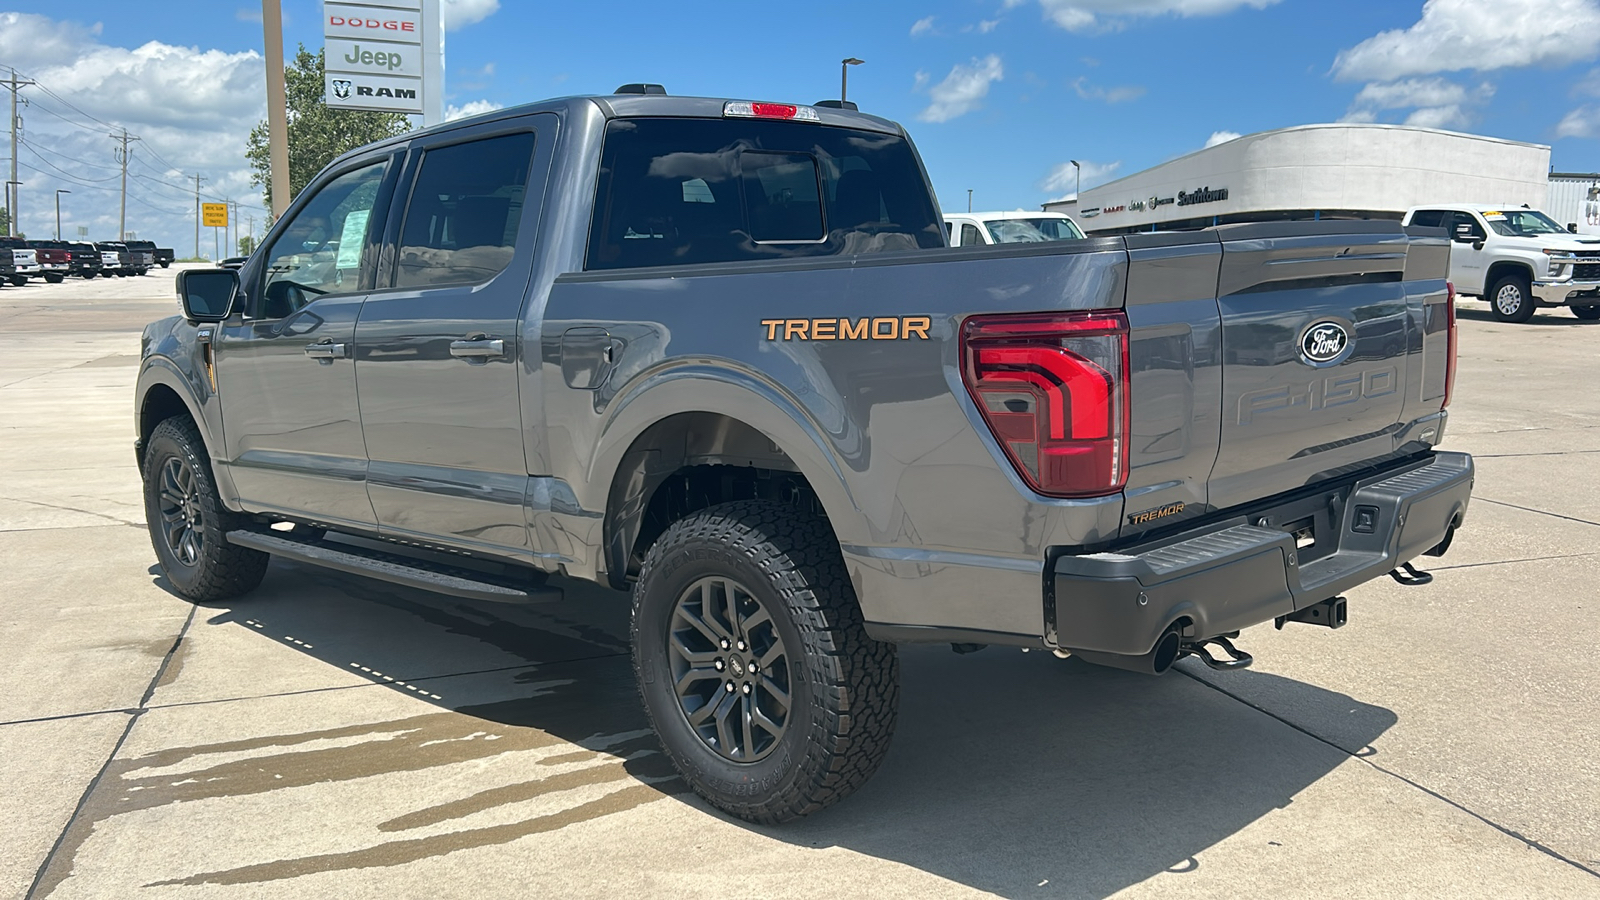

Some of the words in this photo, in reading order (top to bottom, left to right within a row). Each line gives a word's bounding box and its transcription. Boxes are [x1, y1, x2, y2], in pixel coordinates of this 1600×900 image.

[330, 16, 415, 32] DODGE
[344, 45, 402, 71] Jeep
[356, 86, 416, 99] RAM
[1177, 186, 1229, 206] Southtown
[1586, 212, 1600, 226] CE
[760, 316, 932, 341] TREMOR
[1310, 328, 1341, 355] Ford
[1237, 365, 1398, 425] F-150
[1132, 503, 1185, 525] TREMOR
